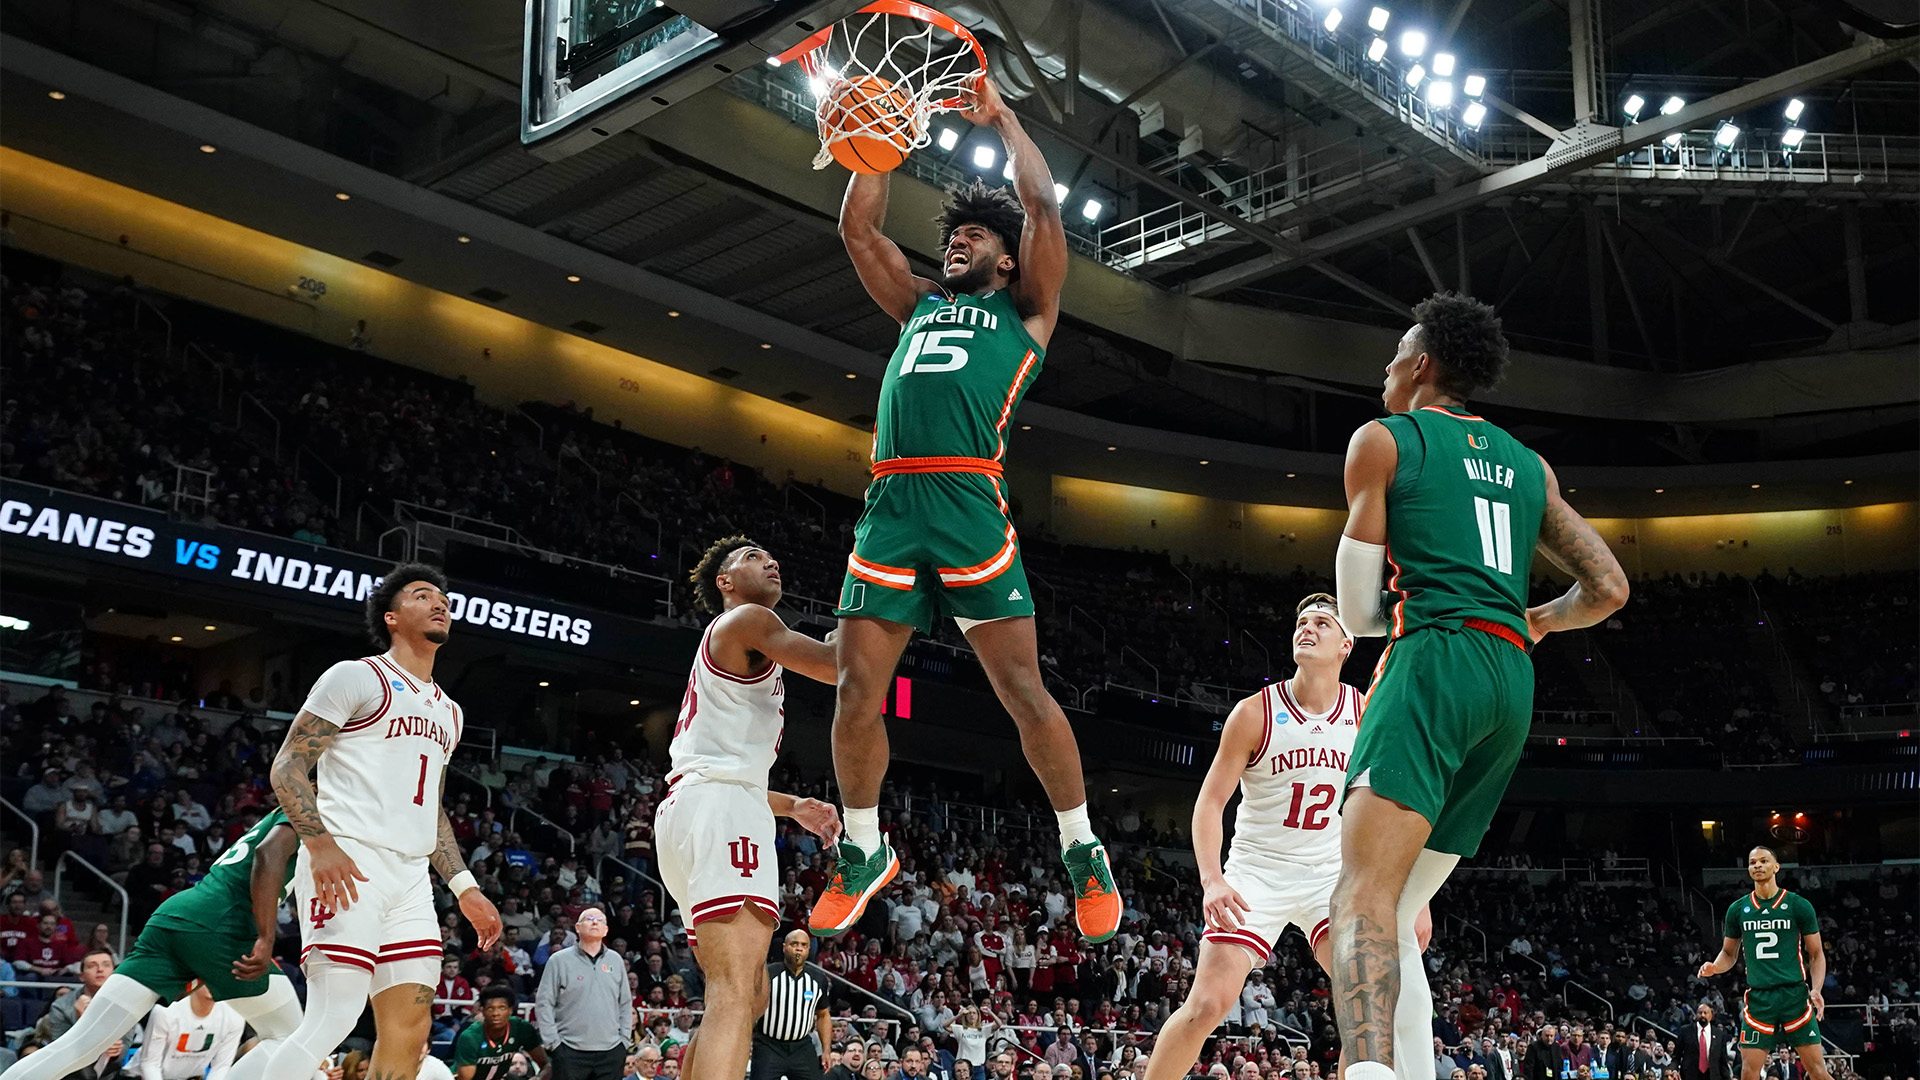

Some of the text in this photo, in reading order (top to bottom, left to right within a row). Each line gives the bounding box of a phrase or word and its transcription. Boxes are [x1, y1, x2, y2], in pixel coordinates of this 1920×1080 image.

[899, 330, 975, 377] 15
[1474, 496, 1513, 575] 11
[1826, 525, 1842, 536] 215
[0, 500, 593, 646] CANES VS INDIAN OOSIERS
[413, 754, 428, 806] 1
[1283, 782, 1336, 831] 12
[1754, 932, 1780, 959] 2
